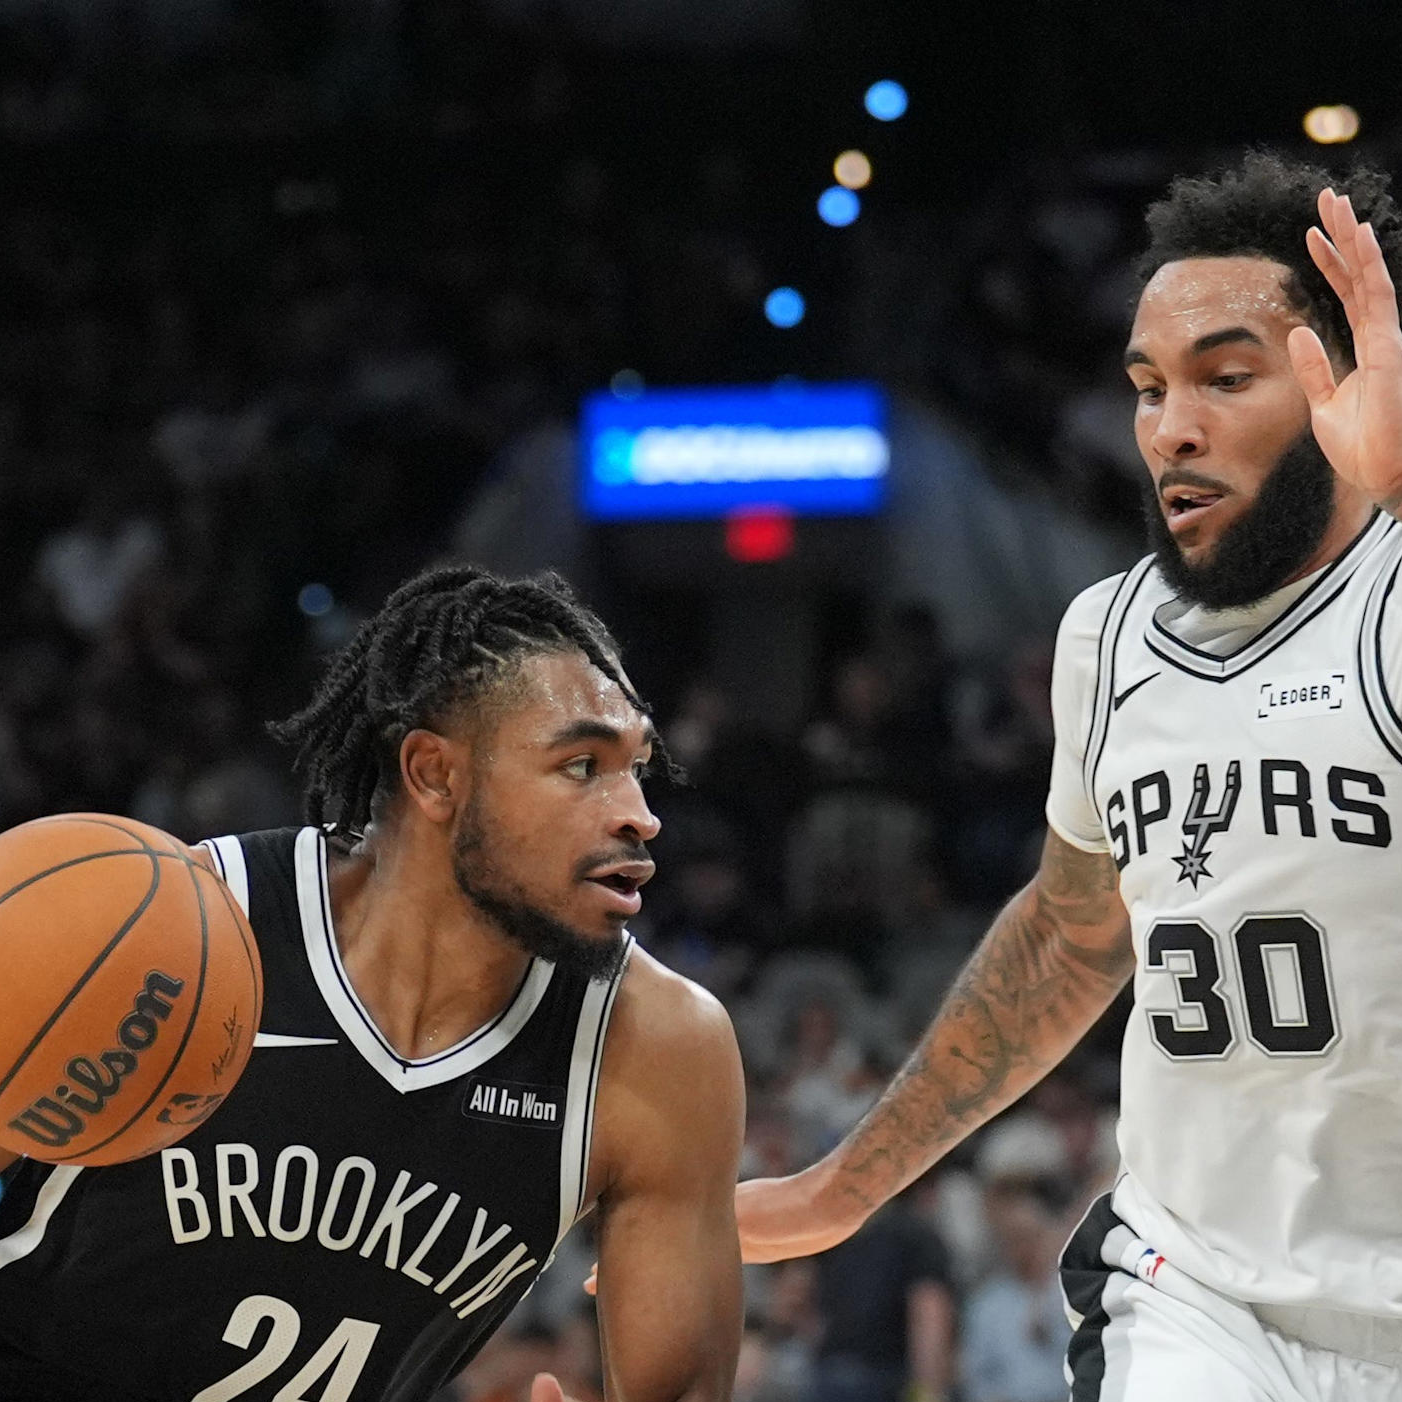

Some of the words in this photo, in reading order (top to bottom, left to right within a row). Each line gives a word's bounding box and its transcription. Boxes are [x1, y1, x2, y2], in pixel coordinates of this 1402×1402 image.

[1269, 685, 1331, 707] LEDGER
[1107, 760, 1393, 888] SPURS
[1145, 911, 1342, 1063] 30
[8, 969, 184, 1147] Wilson
[469, 1084, 497, 1113] All
[499, 1089, 519, 1117] In
[521, 1091, 557, 1121] Won
[161, 1143, 537, 1320] BROOKLYN
